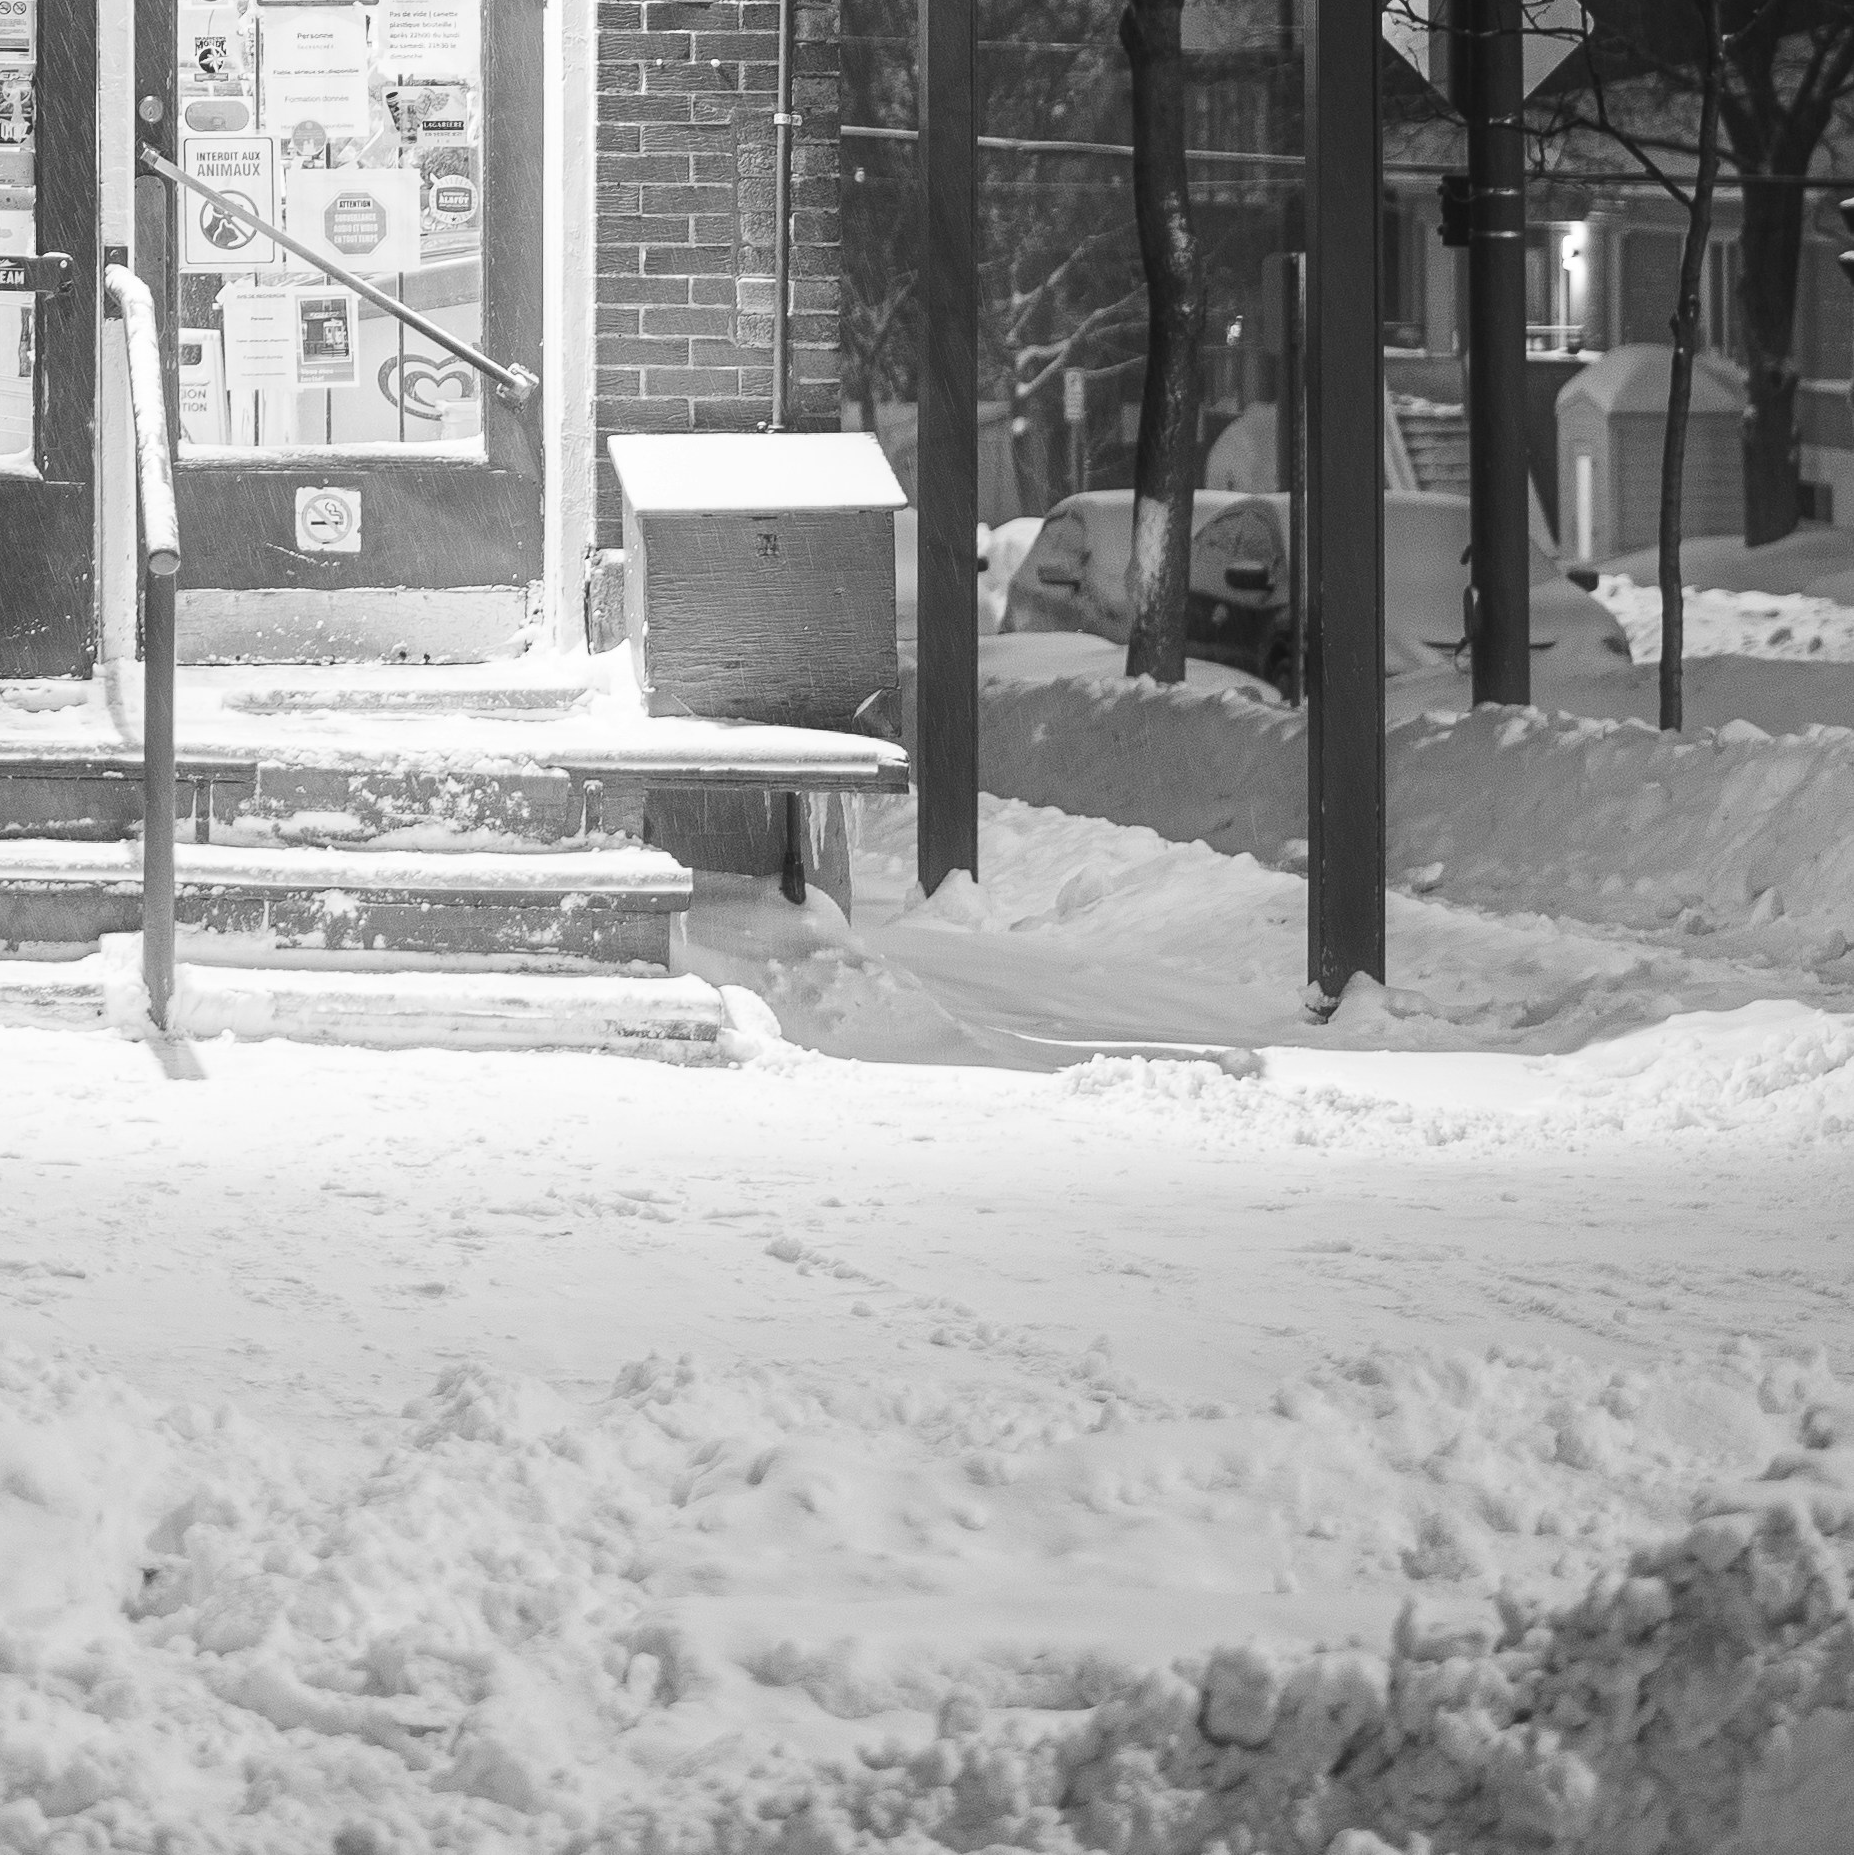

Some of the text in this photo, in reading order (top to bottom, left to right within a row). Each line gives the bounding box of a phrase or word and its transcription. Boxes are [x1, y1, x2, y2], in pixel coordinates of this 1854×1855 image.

[196, 151, 261, 161] INTERDIT AUX
[196, 162, 261, 177] ANIMAUX
[339, 200, 371, 208] ATTENTION
